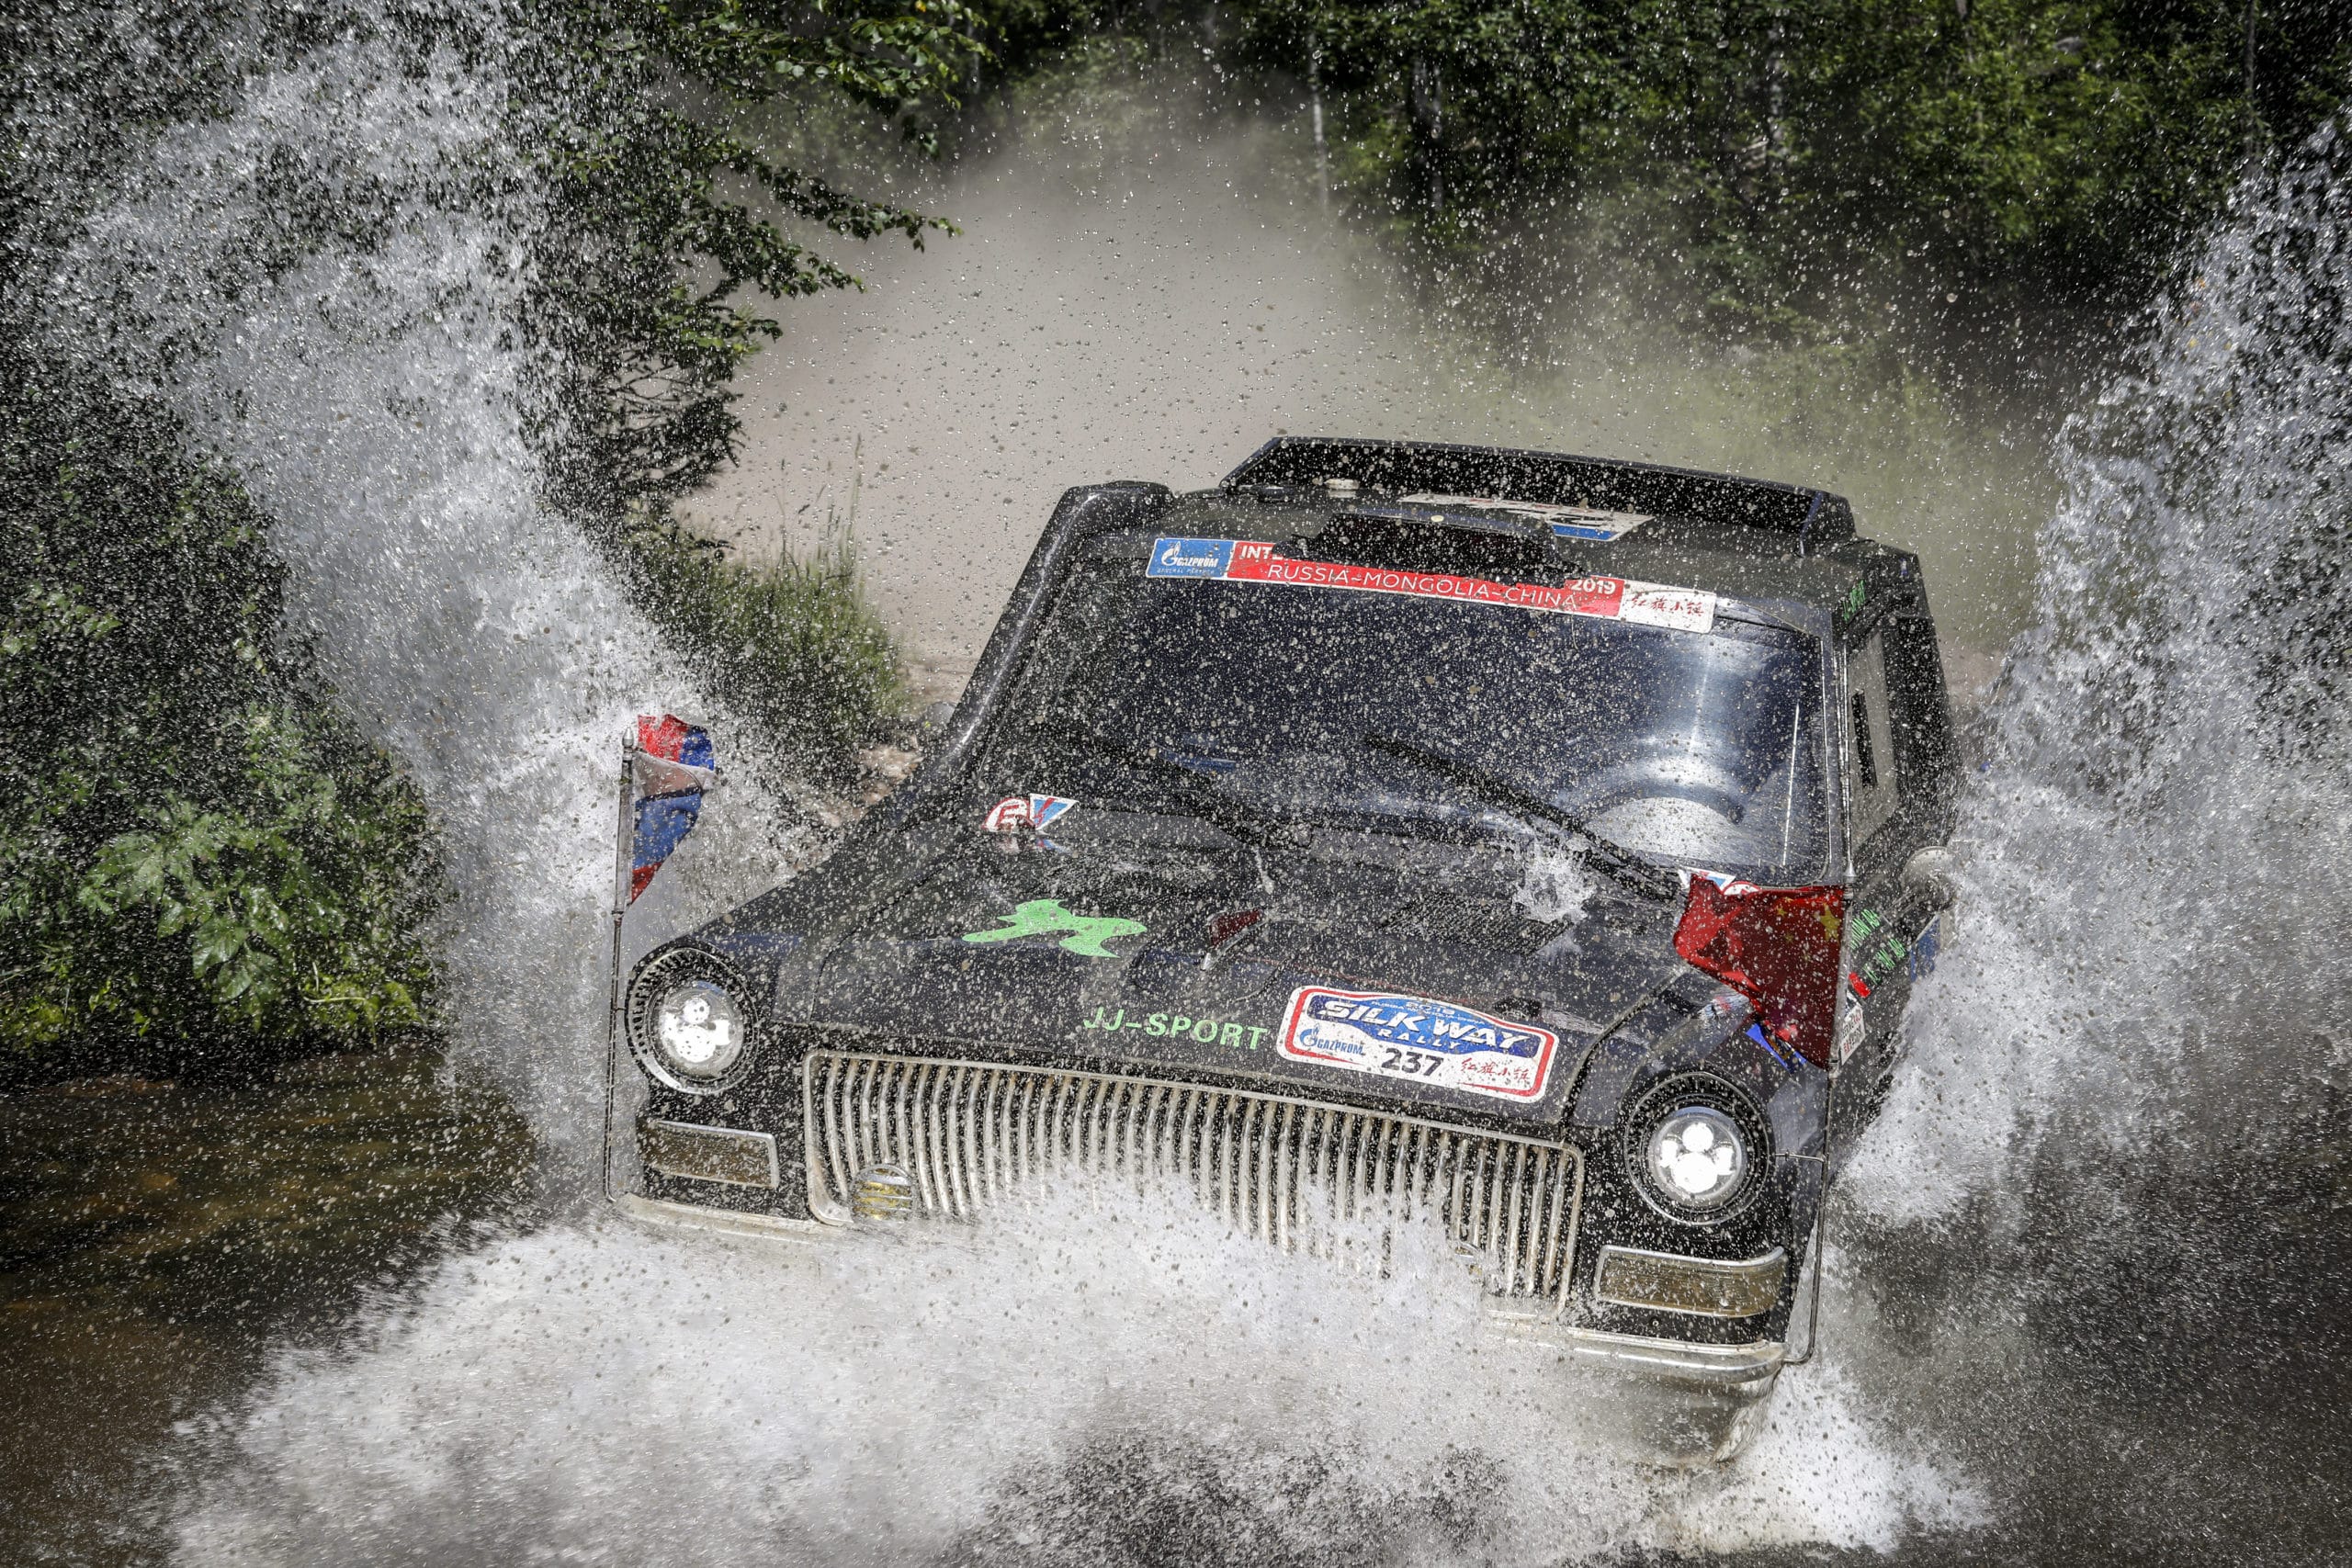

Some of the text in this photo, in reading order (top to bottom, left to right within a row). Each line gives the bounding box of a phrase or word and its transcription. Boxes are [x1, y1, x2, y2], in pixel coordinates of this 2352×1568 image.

[1177, 557, 1219, 569] GAZPROM
[1571, 578, 1616, 595] 2019
[1082, 1006, 1269, 1051] JJ-SPORT
[1318, 999, 1532, 1051] SILK WAY
[1317, 1040, 1363, 1055] GAZPROM
[1377, 1028, 1462, 1049] RALLY
[1381, 1047, 1444, 1077] 237
